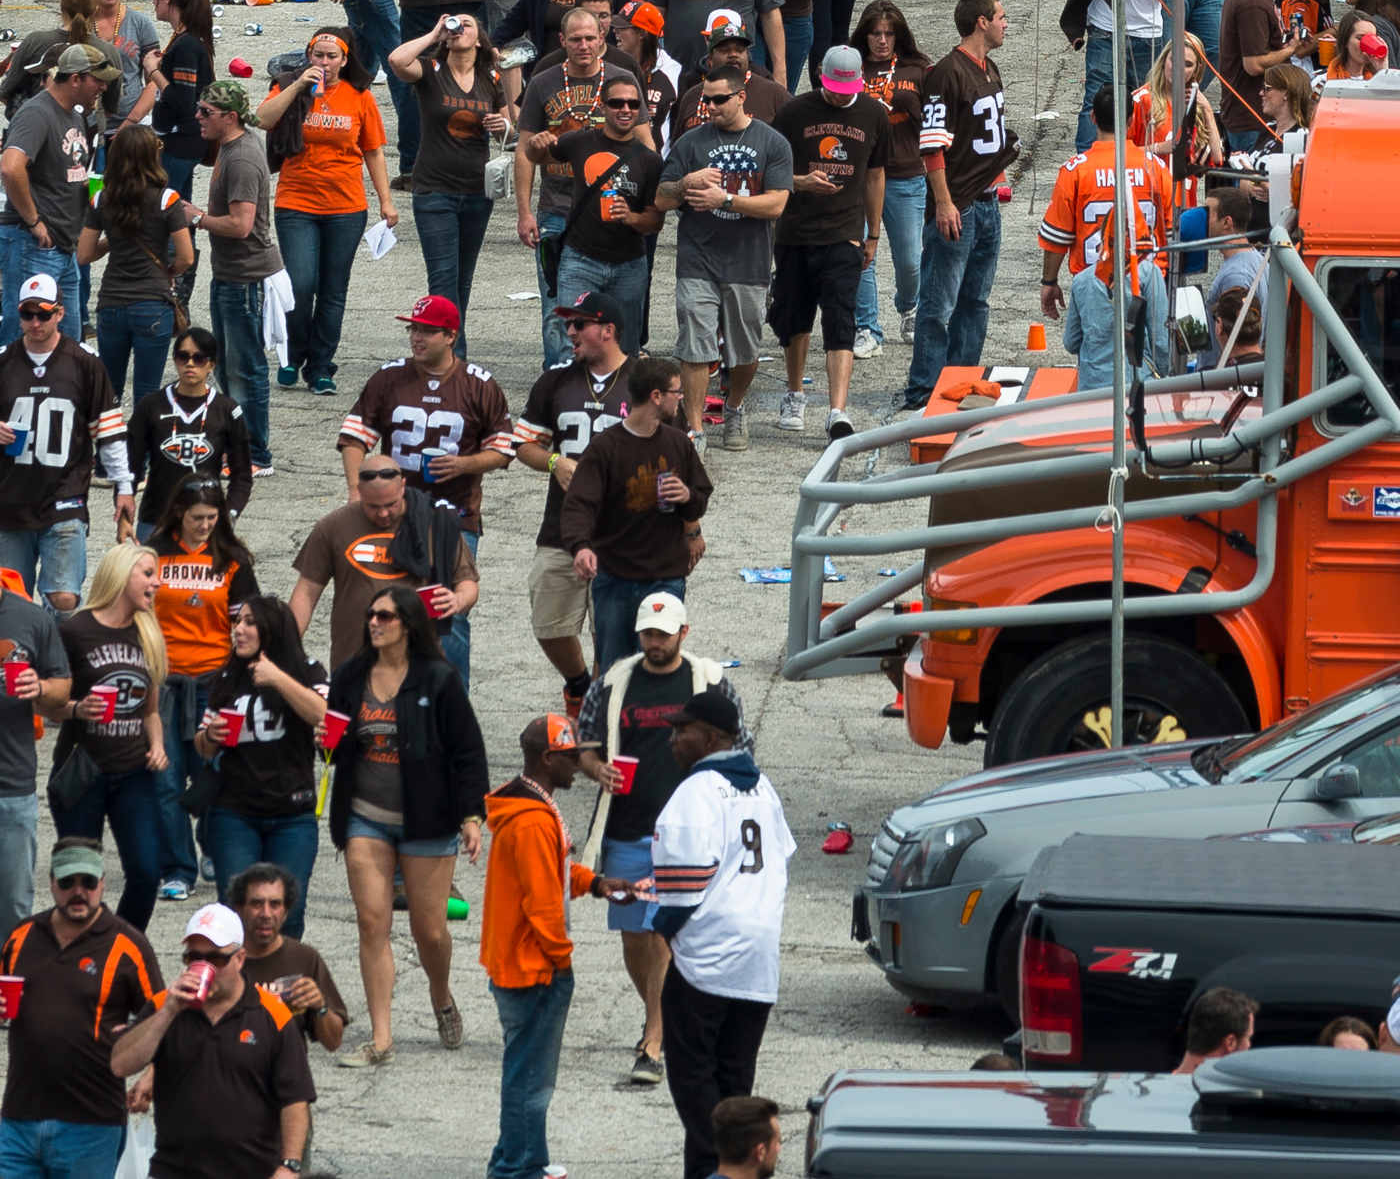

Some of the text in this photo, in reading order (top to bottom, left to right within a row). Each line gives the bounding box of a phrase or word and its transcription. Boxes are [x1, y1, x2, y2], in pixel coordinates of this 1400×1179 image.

[442, 95, 490, 113] BROWNS
[922, 103, 947, 128] 32
[803, 123, 865, 142] CLEVELAND
[707, 144, 758, 159] CLEVELAND
[1095, 168, 1145, 188] HAEN
[8, 396, 76, 468] 40
[391, 405, 465, 473] 23
[162, 563, 226, 585] BROWNS
[739, 818, 764, 875] 9
[1087, 946, 1178, 972] Z71
